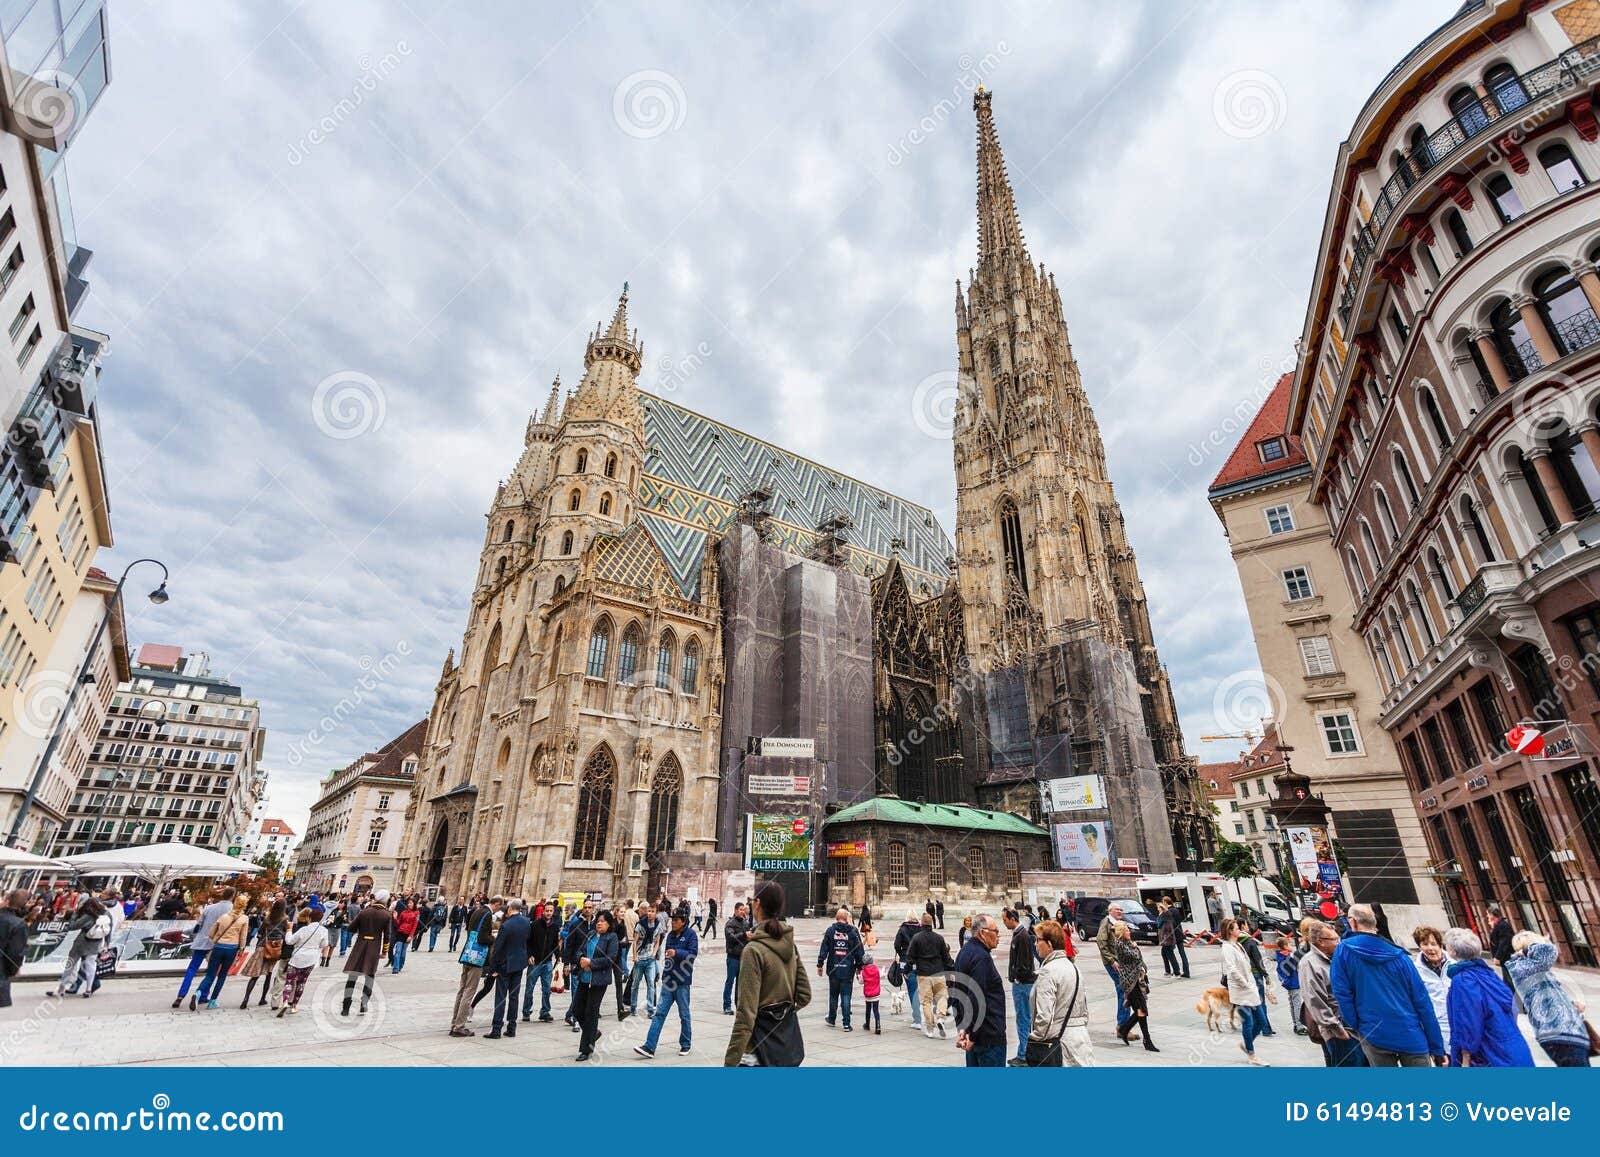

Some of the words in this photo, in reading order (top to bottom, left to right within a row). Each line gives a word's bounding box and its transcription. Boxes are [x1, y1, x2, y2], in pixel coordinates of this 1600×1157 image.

[754, 831, 779, 842] MONET
[780, 832, 792, 843] BIS
[753, 842, 785, 852] PICASSO
[752, 859, 806, 870] ALBERTINA
